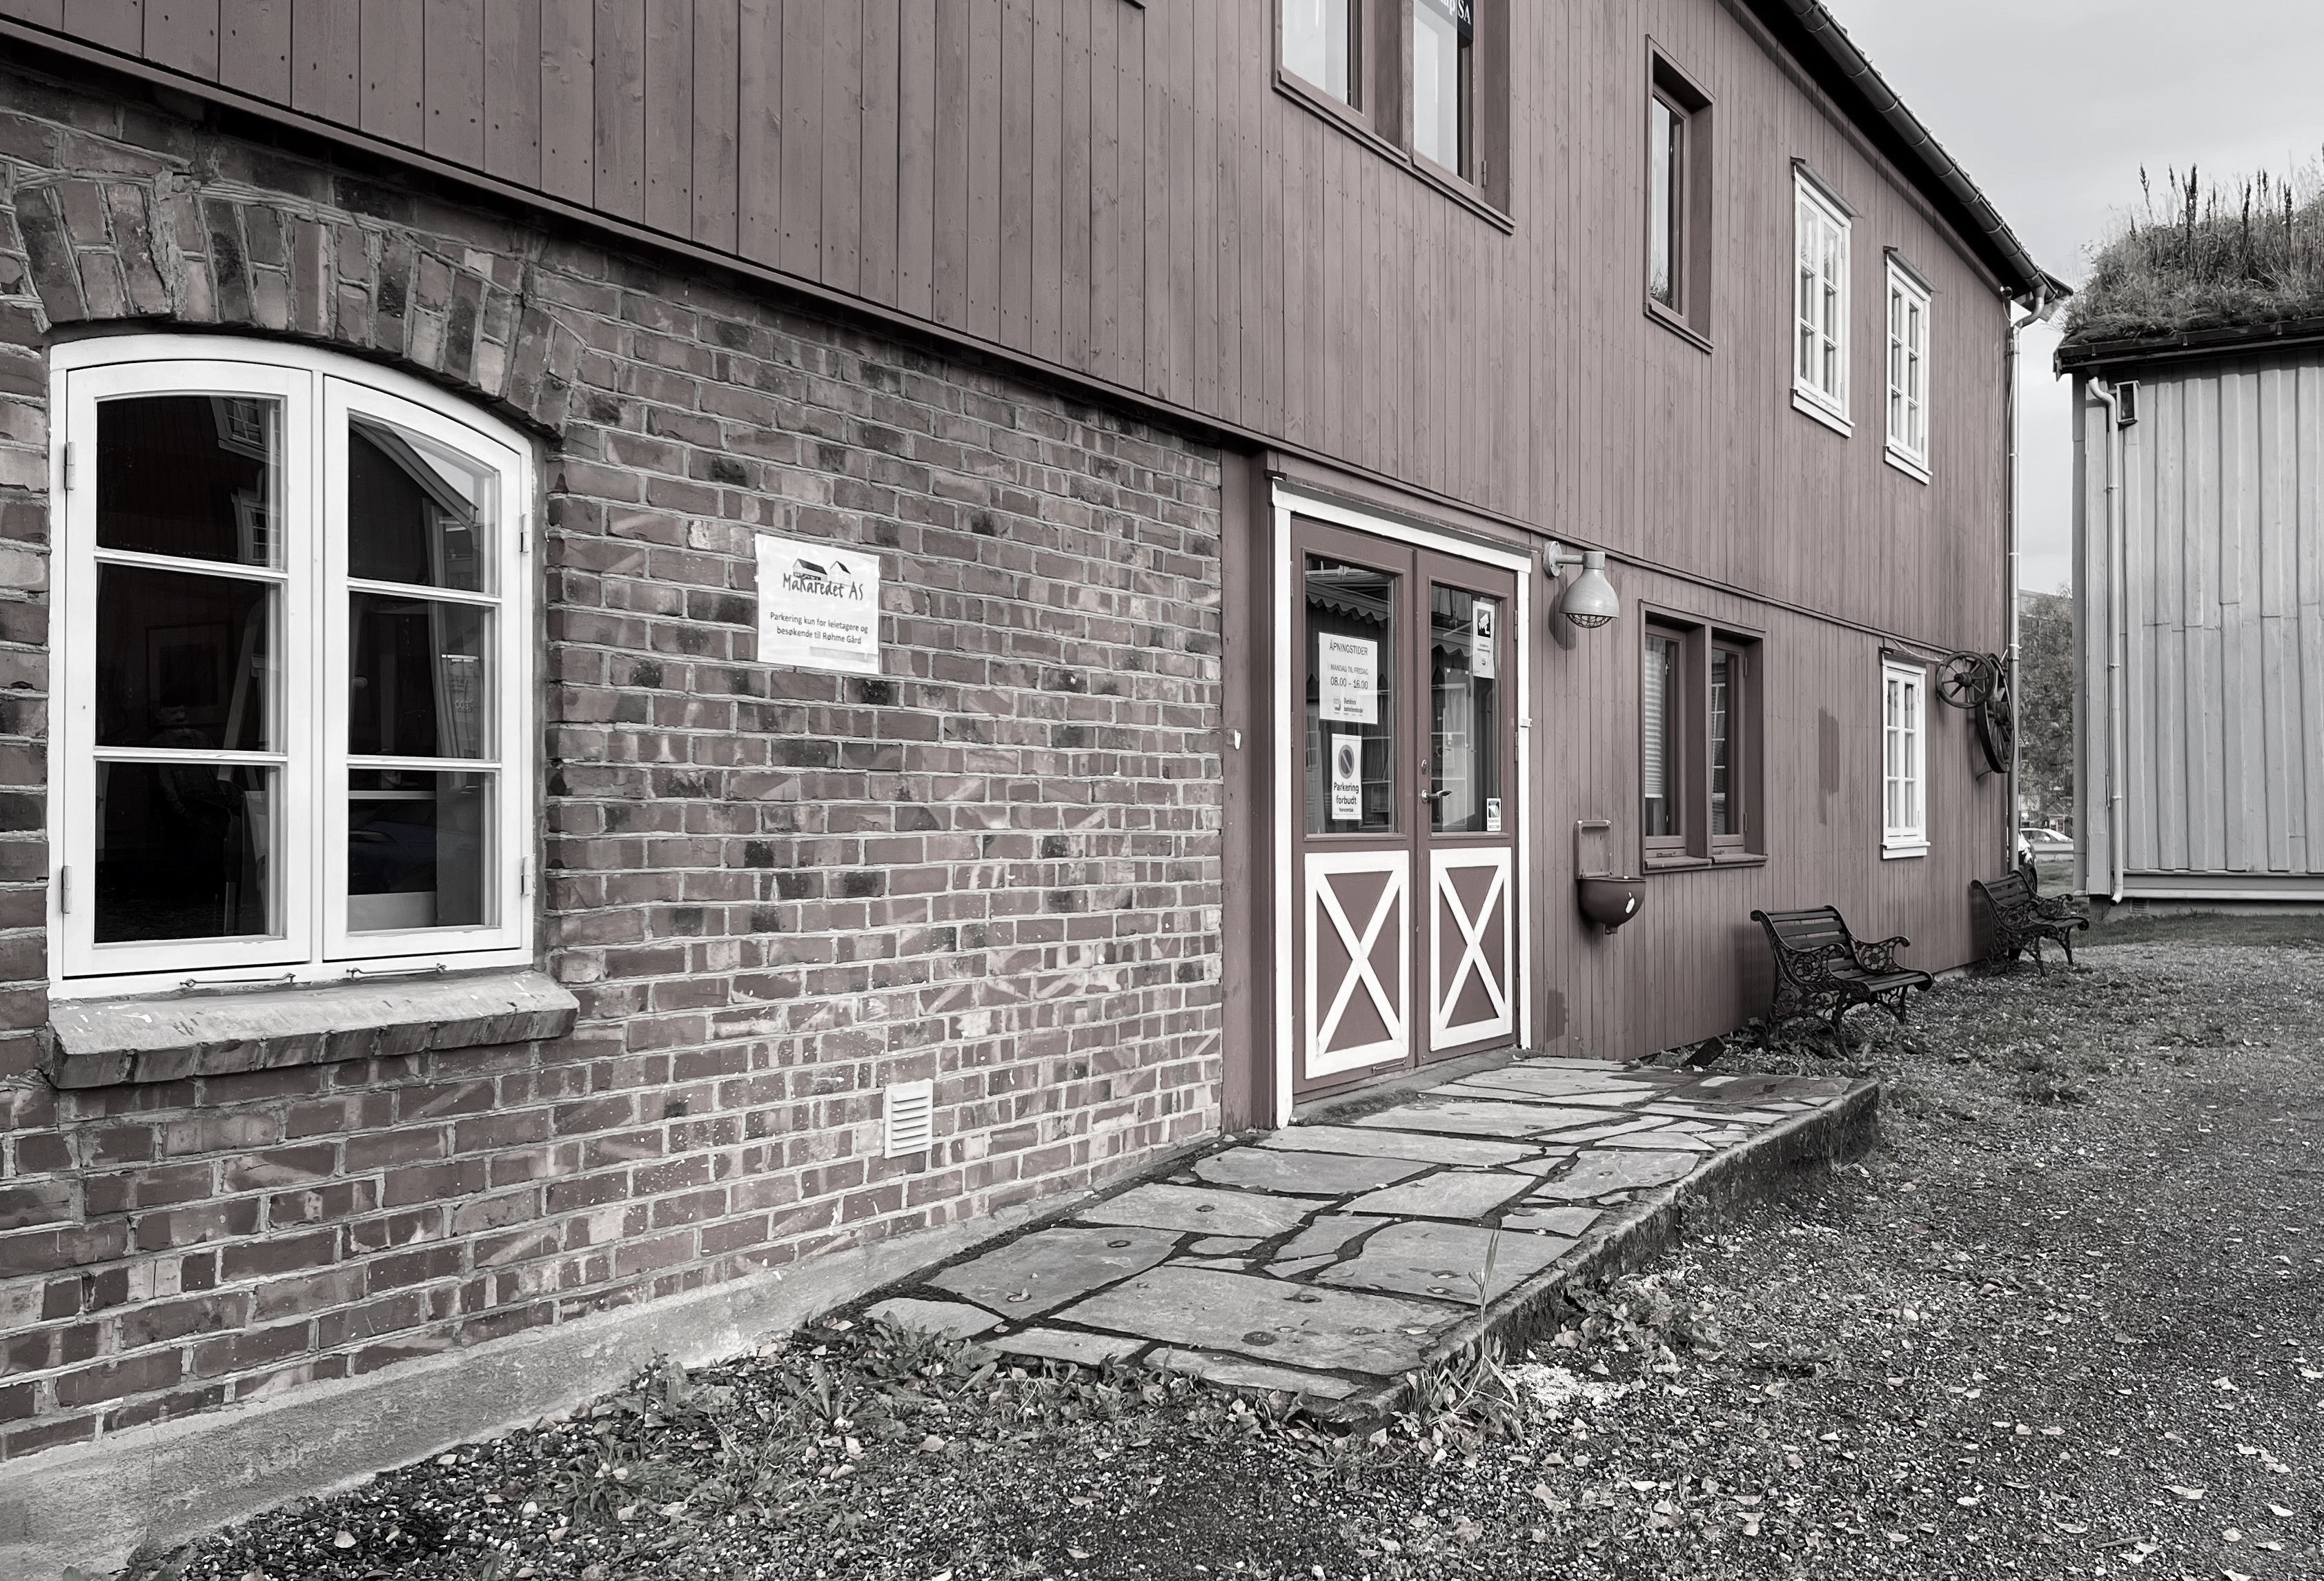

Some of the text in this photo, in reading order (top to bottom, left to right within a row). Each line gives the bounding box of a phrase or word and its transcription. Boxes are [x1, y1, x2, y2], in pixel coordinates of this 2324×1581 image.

[849, 581, 863, 600] AS
[770, 611, 869, 634] Parkering kun for leietagere og
[777, 626, 813, 638] besøkende
[823, 632, 845, 642] Røhme
[846, 635, 862, 644] Gård
[1329, 639, 1368, 656] ÅPNINGSTIDER
[1330, 676, 1347, 687] 08.00
[1353, 679, 1368, 689] 16.00
[1334, 781, 1359, 794] Parkering
[1336, 795, 1357, 805] forbudt
